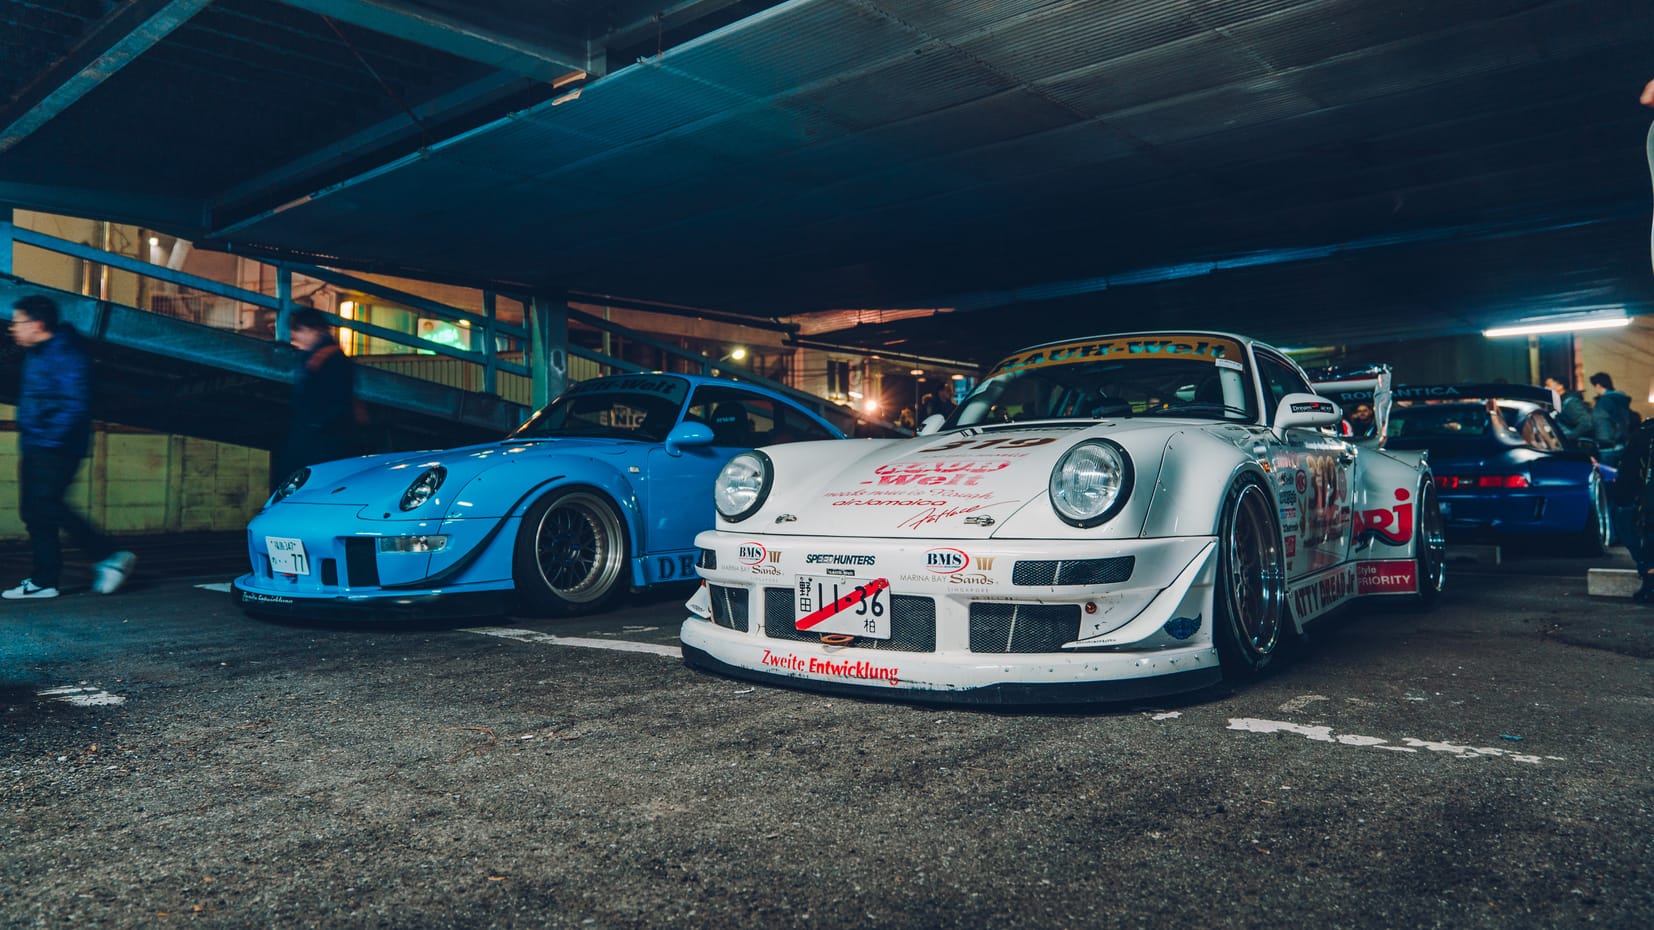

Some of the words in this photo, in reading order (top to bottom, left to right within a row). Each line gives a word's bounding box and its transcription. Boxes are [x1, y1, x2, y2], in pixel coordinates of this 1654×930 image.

[1341, 386, 1459, 401] RONTICA
[739, 546, 762, 558] BMS
[927, 553, 962, 565] BMS
[931, 575, 947, 583] BAY
[949, 573, 995, 585] Sands
[761, 649, 806, 672] Zweite
[808, 657, 899, 686] Entwicklung
